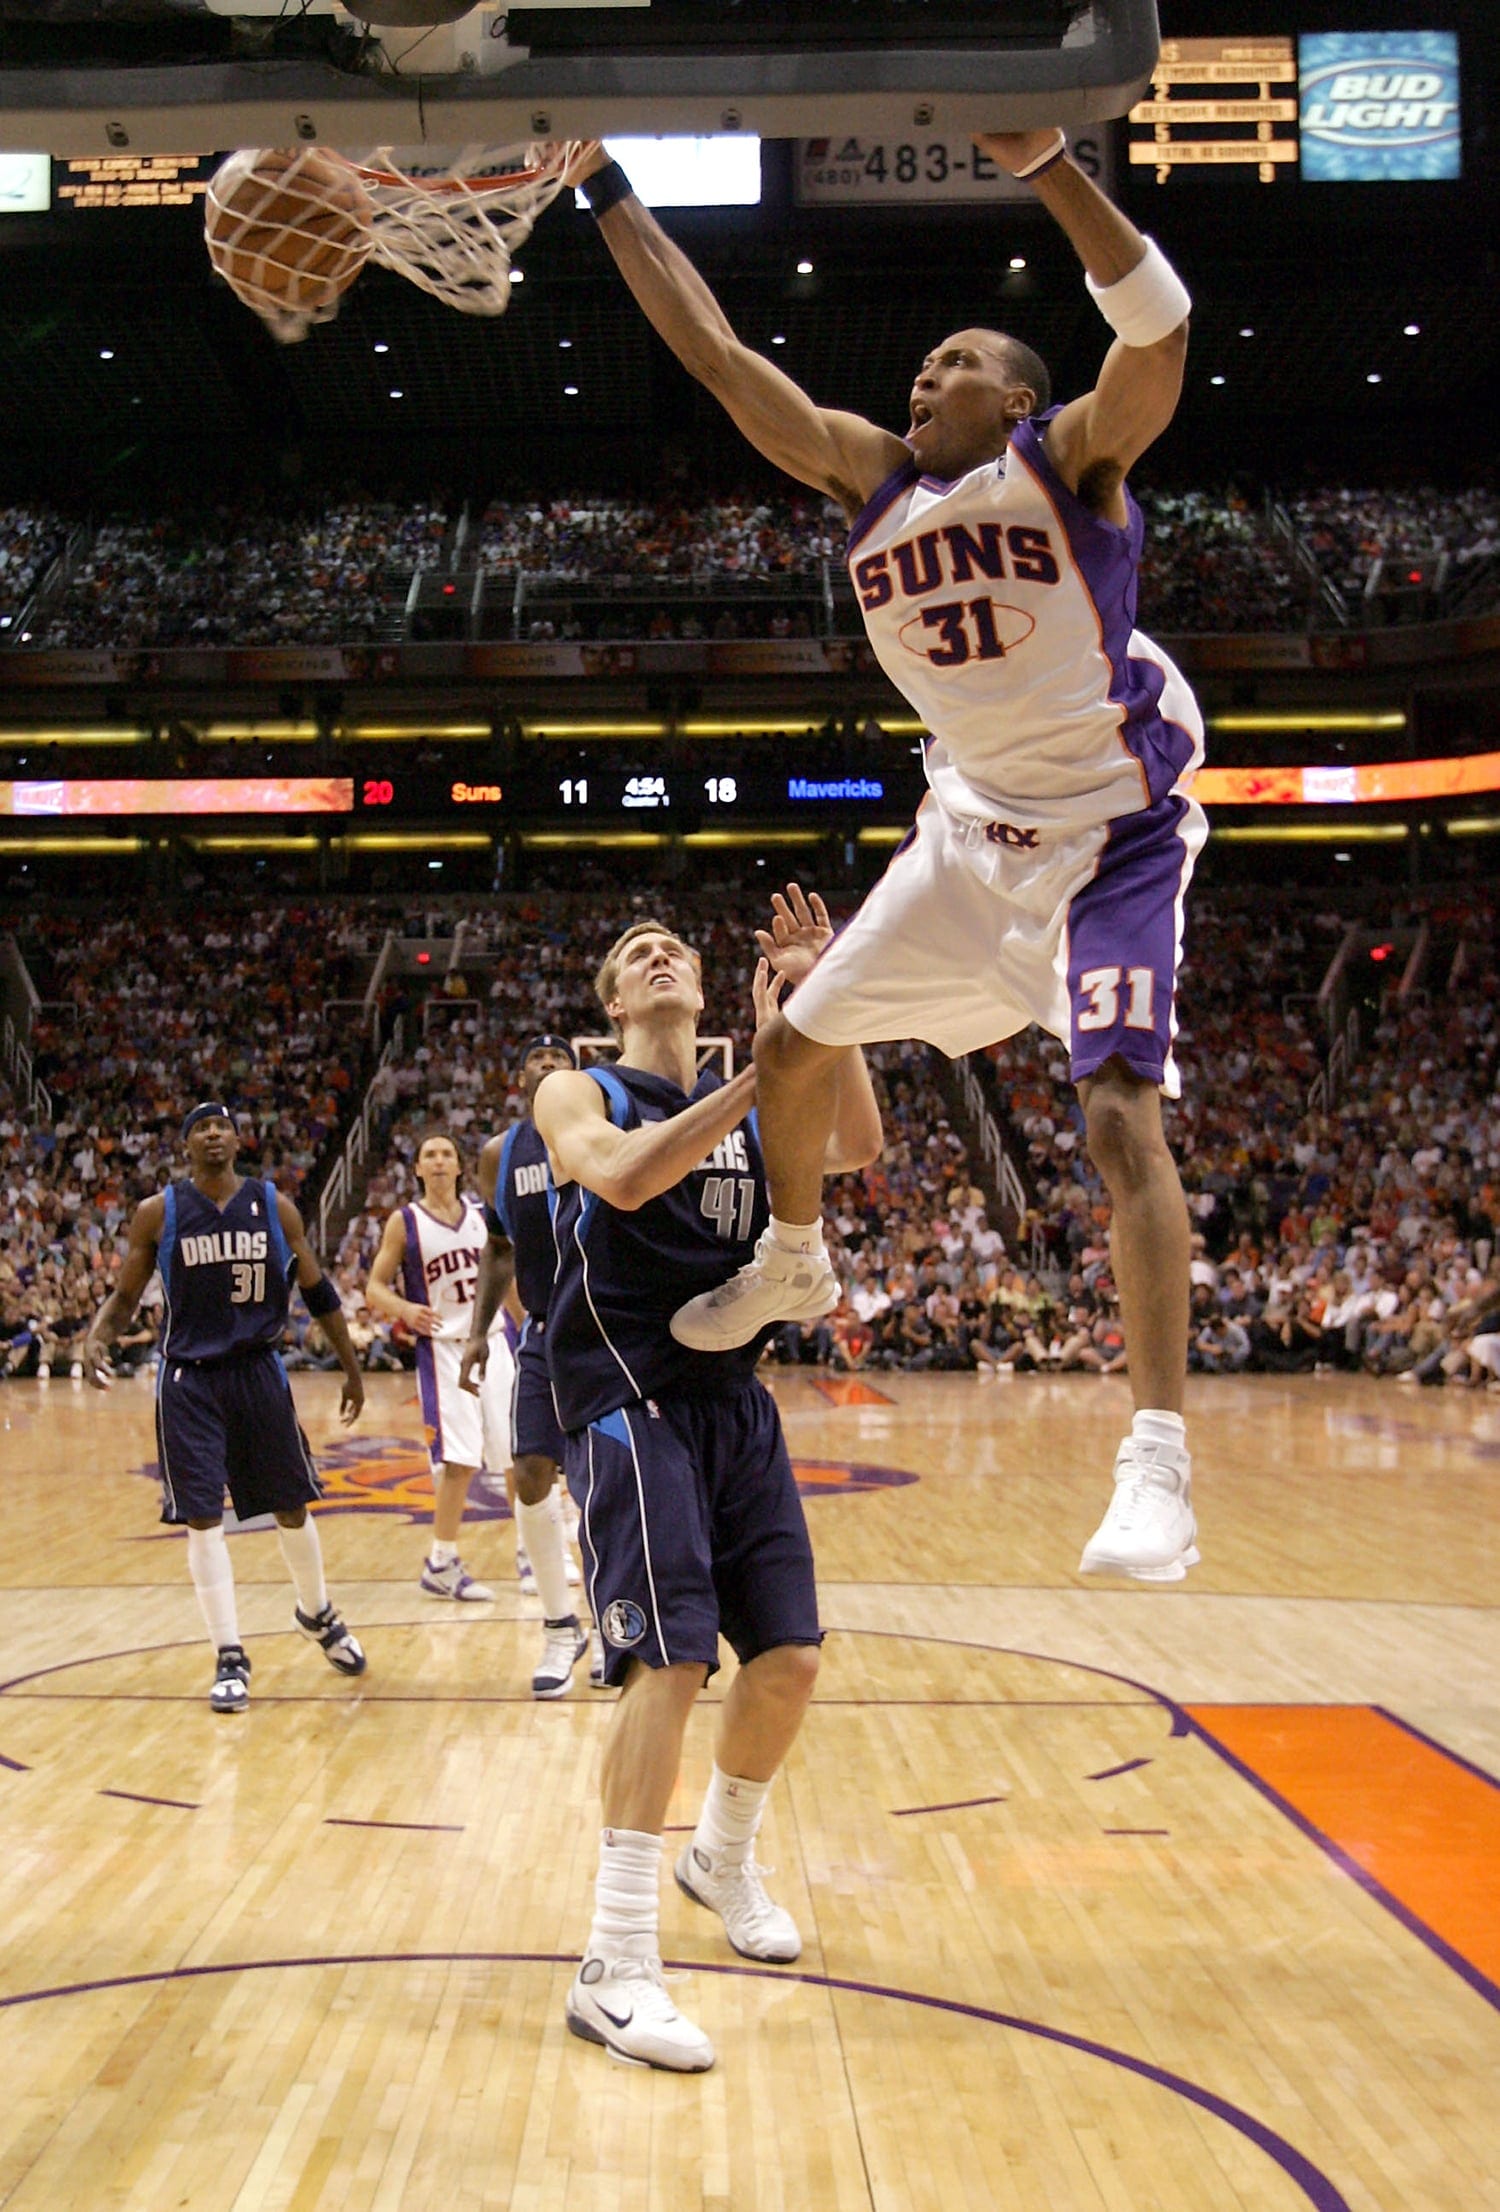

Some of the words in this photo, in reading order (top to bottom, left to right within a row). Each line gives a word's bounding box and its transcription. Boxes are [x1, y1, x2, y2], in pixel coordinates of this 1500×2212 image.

[1329, 73, 1443, 101] BUD
[1300, 102, 1459, 129] LIGHT
[855, 522, 1061, 613] SUNS
[920, 596, 1006, 668] 31
[363, 780, 394, 804] 20
[451, 782, 502, 802] Suns
[559, 779, 588, 804] 11
[704, 777, 738, 802] 18
[788, 778, 884, 799] Mavericks
[1077, 964, 1156, 1033] 31
[700, 1177, 755, 1241] 41
[181, 1231, 268, 1267] DALLAS
[427, 1247, 480, 1284] SUN
[230, 1263, 266, 1304] 31
